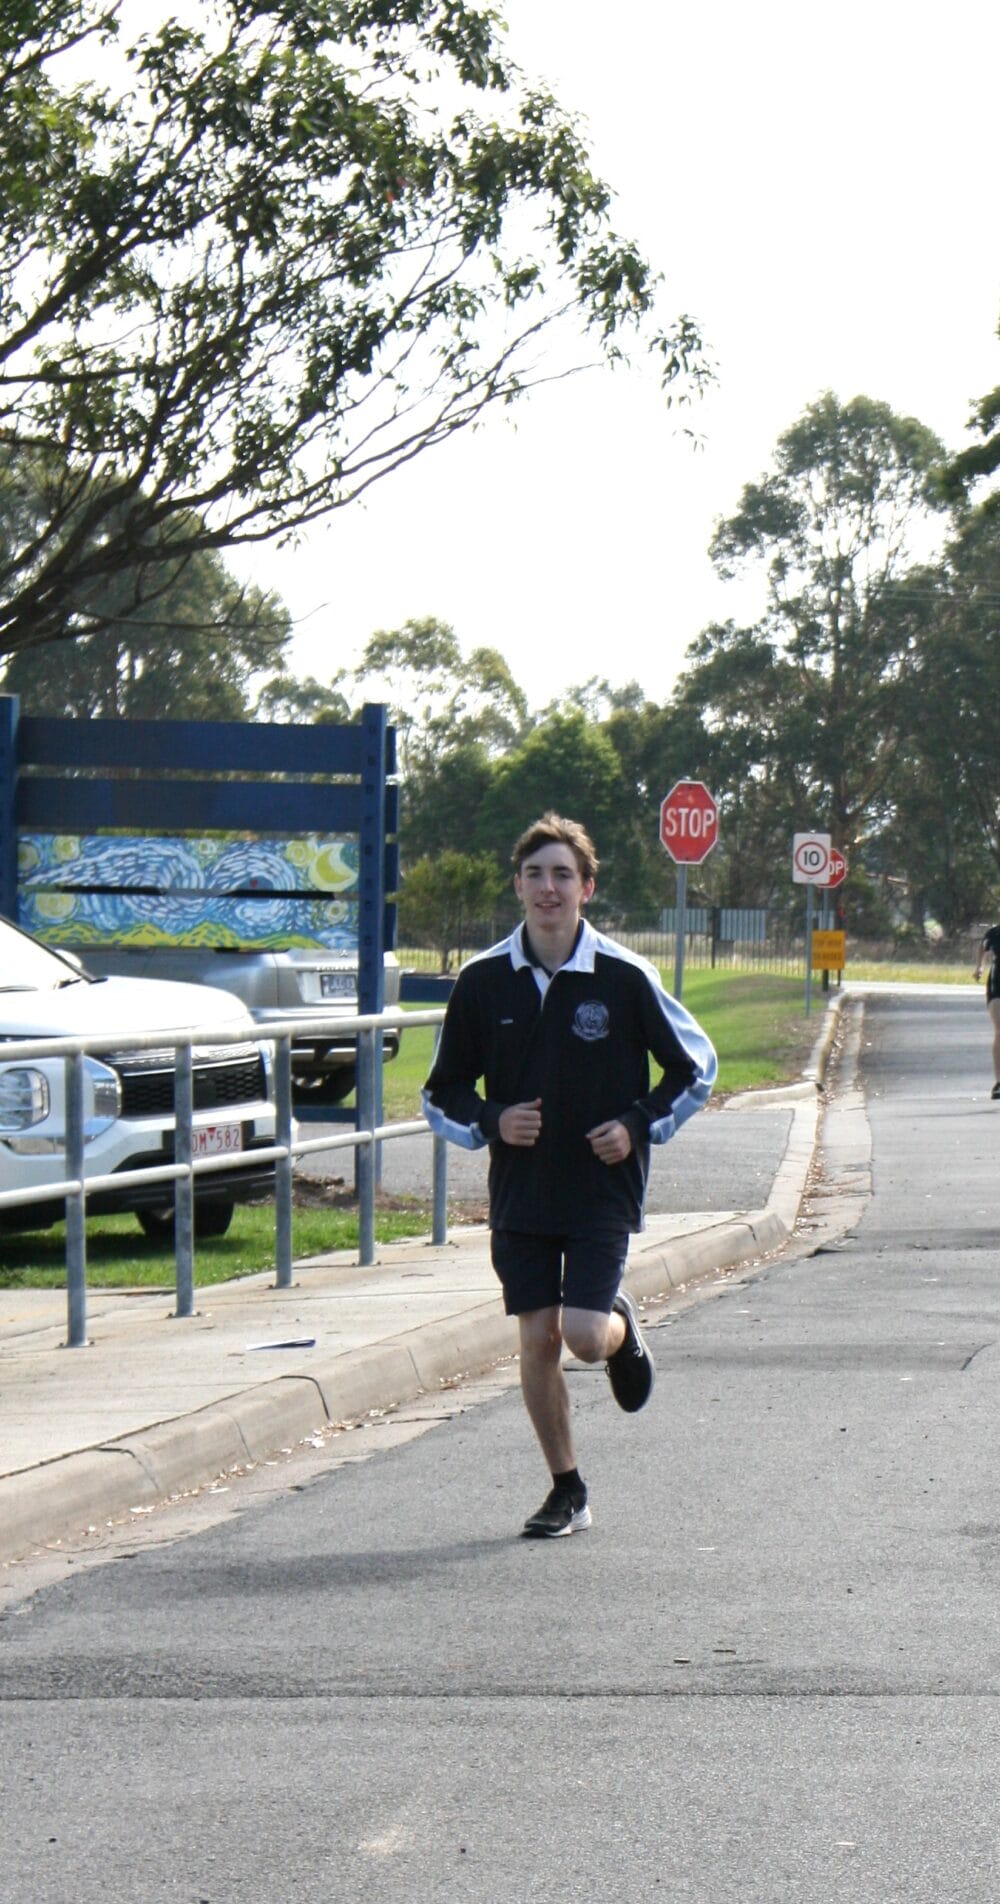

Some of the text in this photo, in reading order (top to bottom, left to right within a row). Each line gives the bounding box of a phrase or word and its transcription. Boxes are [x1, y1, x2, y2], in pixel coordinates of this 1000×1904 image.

[665, 807, 715, 838] STOP
[803, 850, 820, 866] 10
[829, 860, 844, 876] OP
